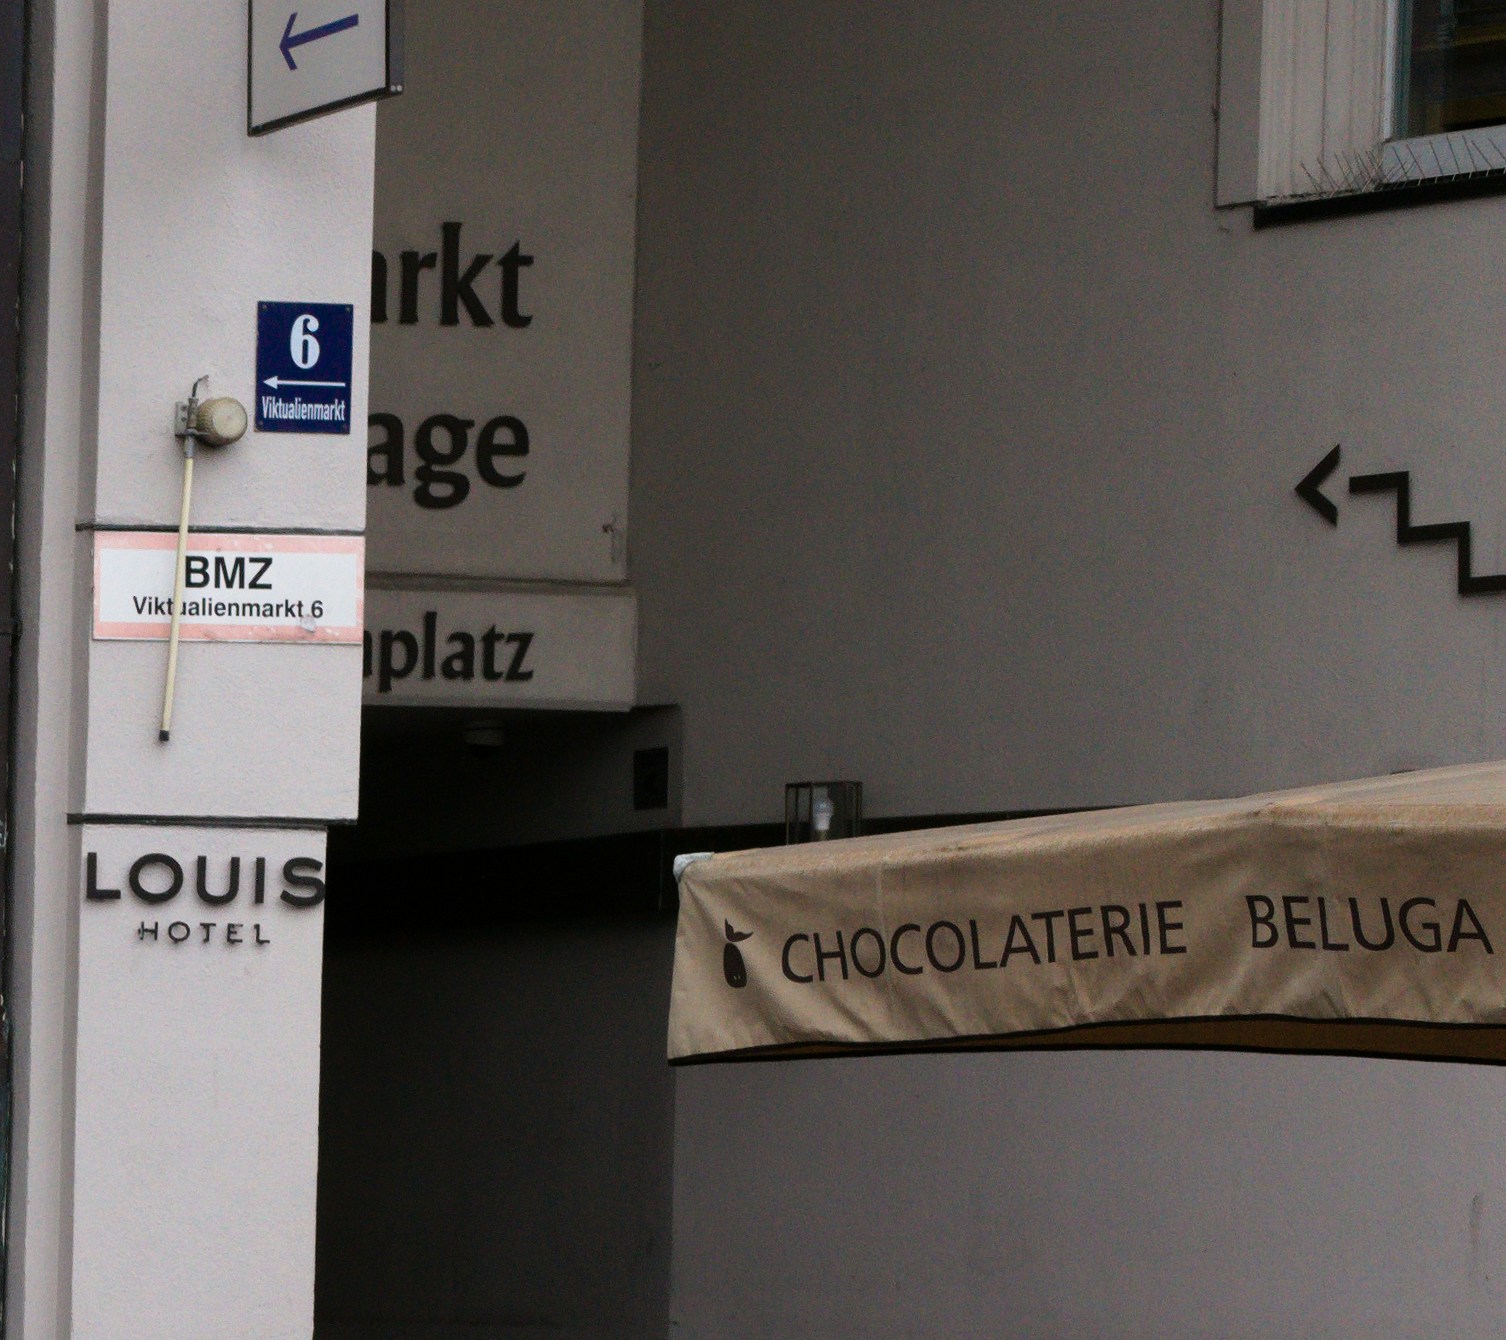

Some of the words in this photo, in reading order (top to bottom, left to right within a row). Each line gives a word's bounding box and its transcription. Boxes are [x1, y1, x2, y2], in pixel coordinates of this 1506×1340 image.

[290, 313, 321, 370] 6
[261, 395, 346, 422] Viktualienmarkt
[184, 555, 273, 590] BMZ
[311, 601, 324, 619] 6
[364, 610, 535, 693] platz
[86, 852, 326, 908] LOUIS
[137, 921, 271, 944] HOTEL
[780, 900, 1188, 984] CHOCOLATERIE
[1245, 895, 1495, 955] BELUGA
